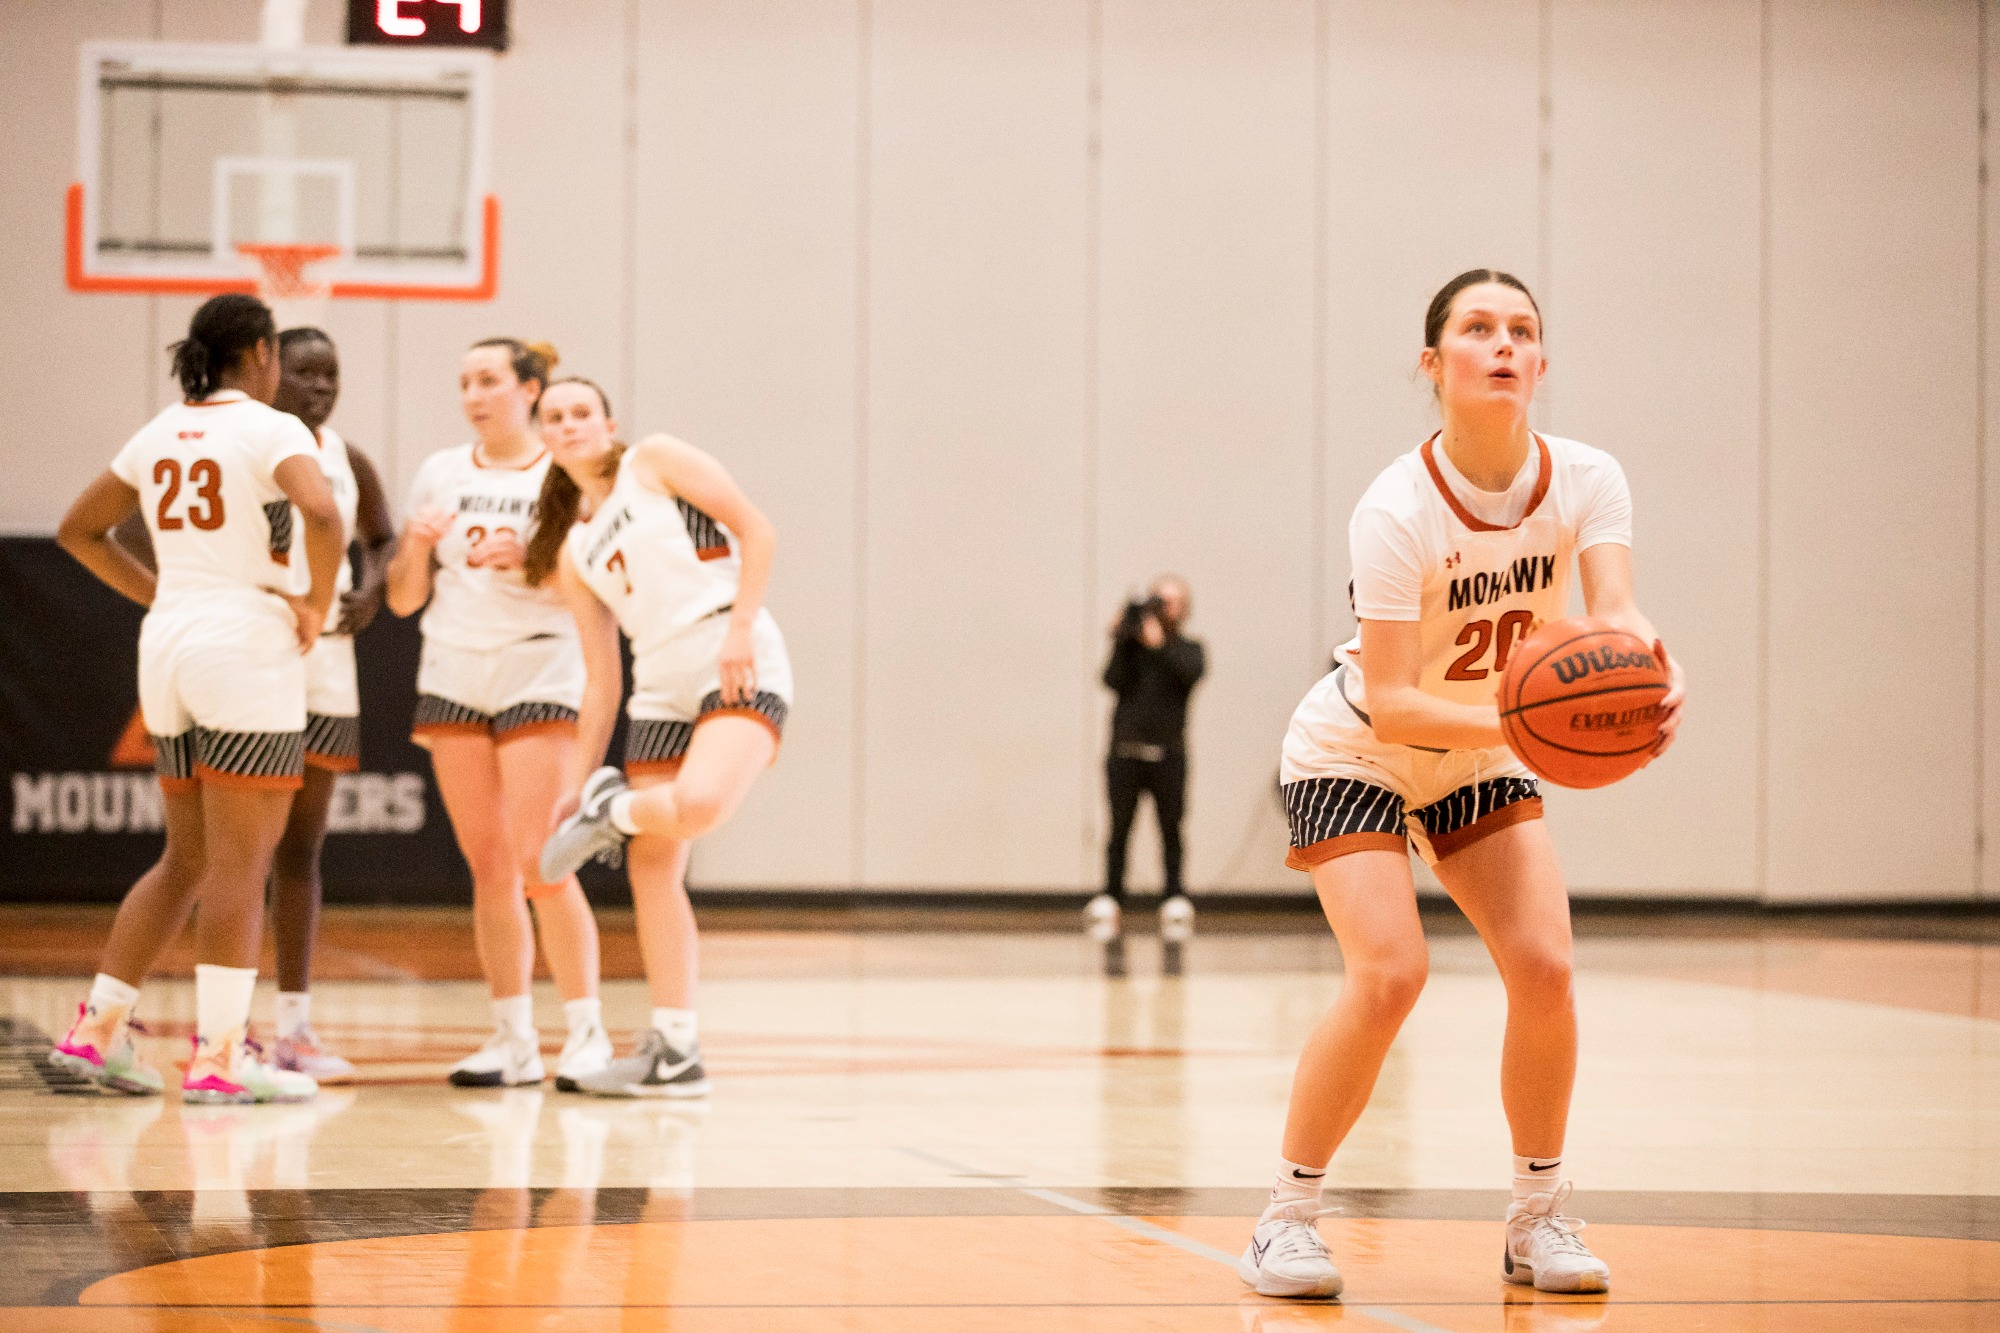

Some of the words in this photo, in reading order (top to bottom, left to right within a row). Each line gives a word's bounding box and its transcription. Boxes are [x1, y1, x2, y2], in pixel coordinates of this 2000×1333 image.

[153, 458, 226, 531] 23
[605, 549, 634, 595] 7
[1448, 554, 1556, 612] MOHAWK
[1550, 645, 1658, 685] Wilson
